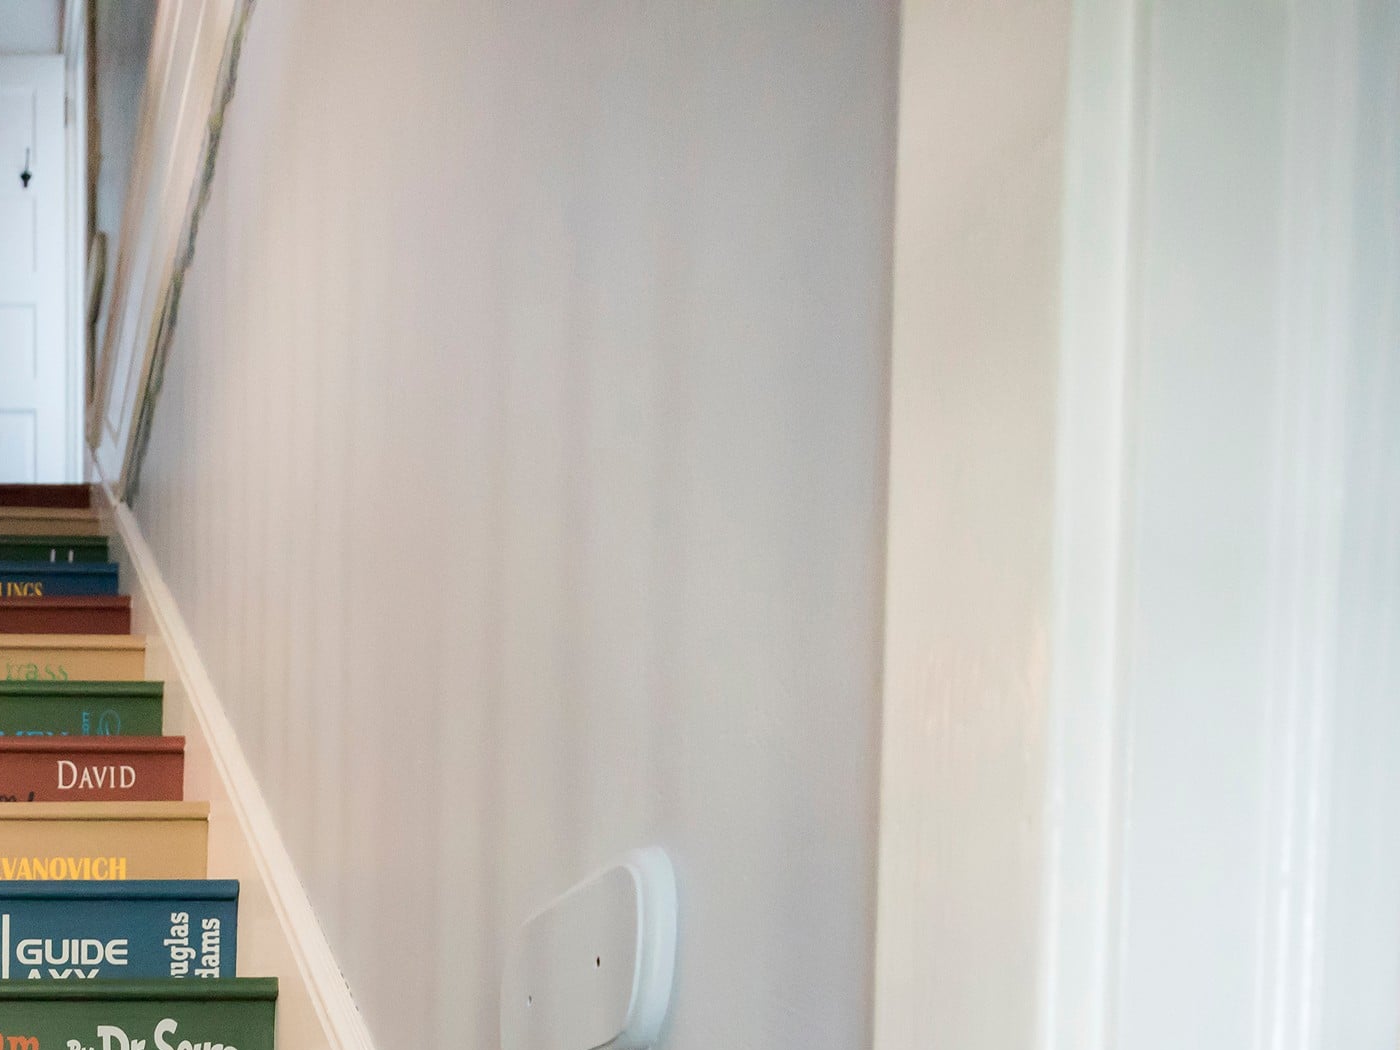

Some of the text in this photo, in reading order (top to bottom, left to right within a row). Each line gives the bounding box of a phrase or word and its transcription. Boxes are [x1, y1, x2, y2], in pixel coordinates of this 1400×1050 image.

[16, 939, 127, 964] GUIDE
[163, 912, 196, 978] uglas
[195, 919, 220, 978] dams
